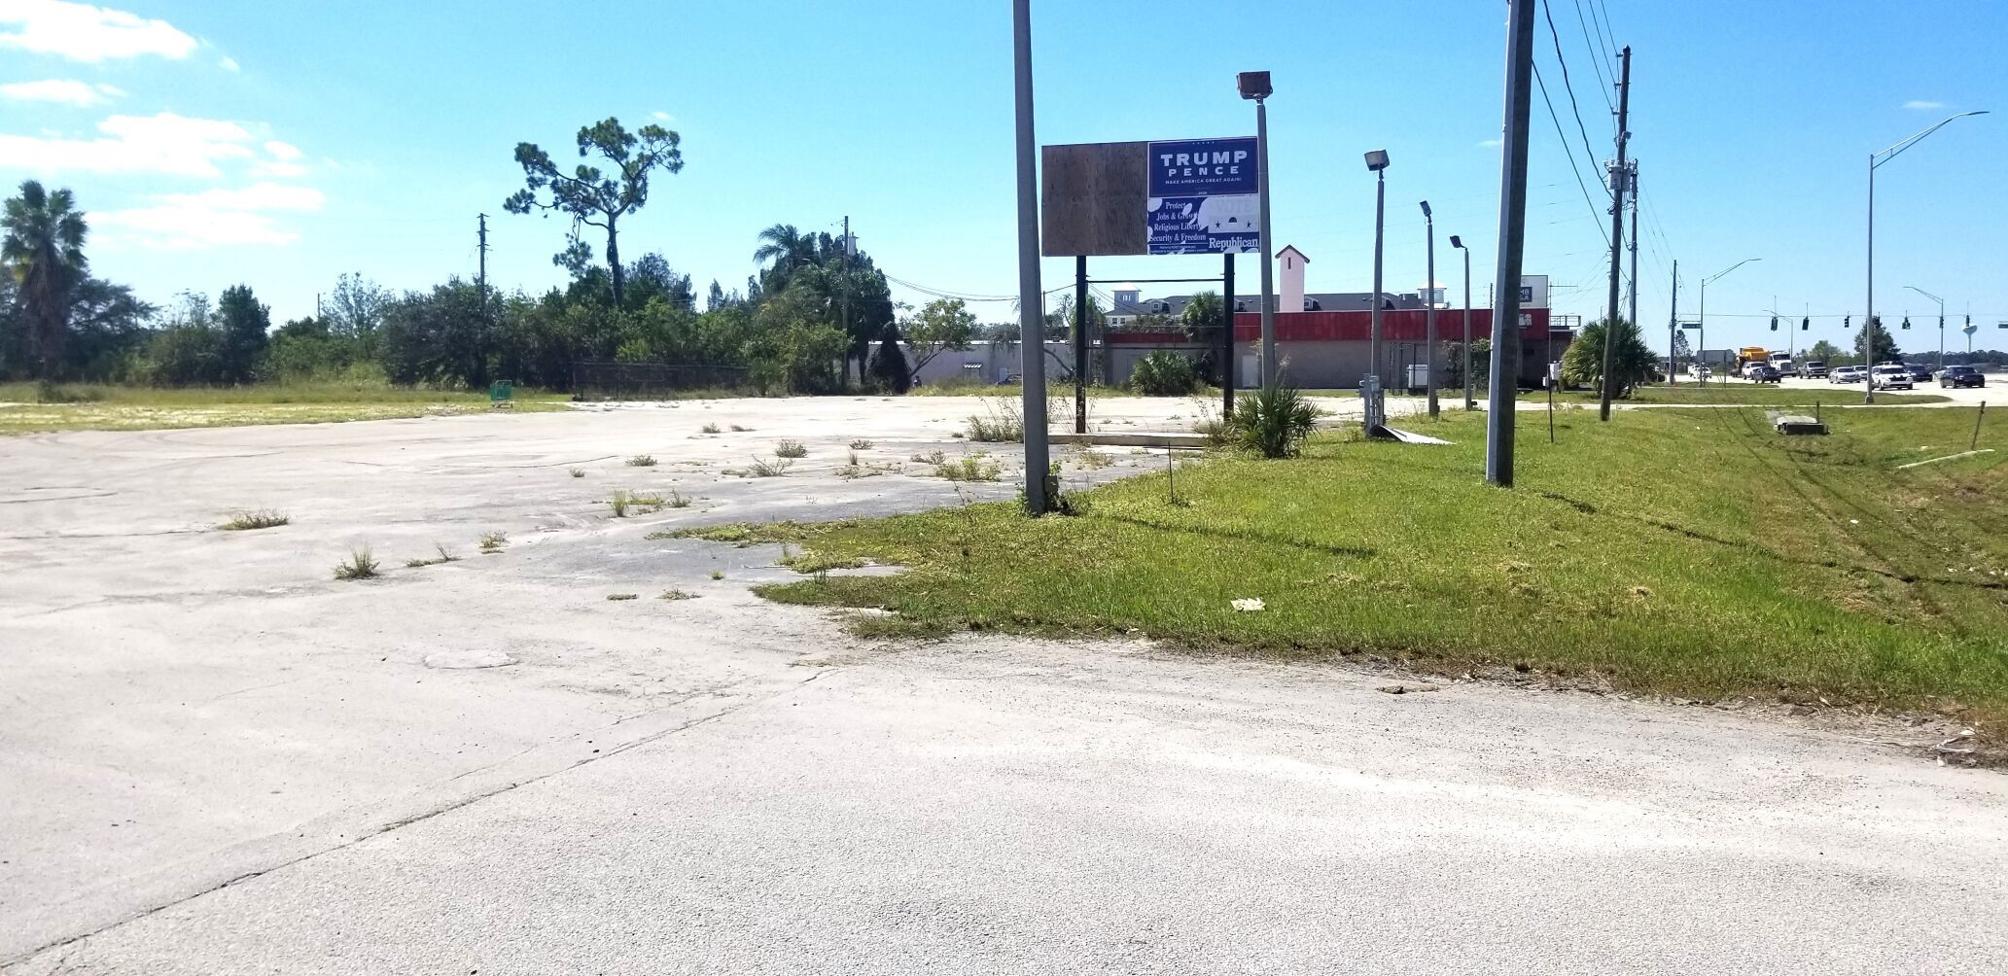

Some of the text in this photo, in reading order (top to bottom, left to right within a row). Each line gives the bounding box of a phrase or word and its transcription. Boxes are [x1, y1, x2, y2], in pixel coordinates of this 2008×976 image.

[1160, 150, 1248, 167] TRUMP
[1168, 165, 1239, 177] PENCE
[1156, 212, 1170, 221] Jobs
[1170, 212, 1176, 220] &
[1154, 223, 1180, 233] Religious
[1174, 233, 1180, 241] &
[1180, 232, 1206, 241] Freedom
[1208, 236, 1258, 251] Republican
